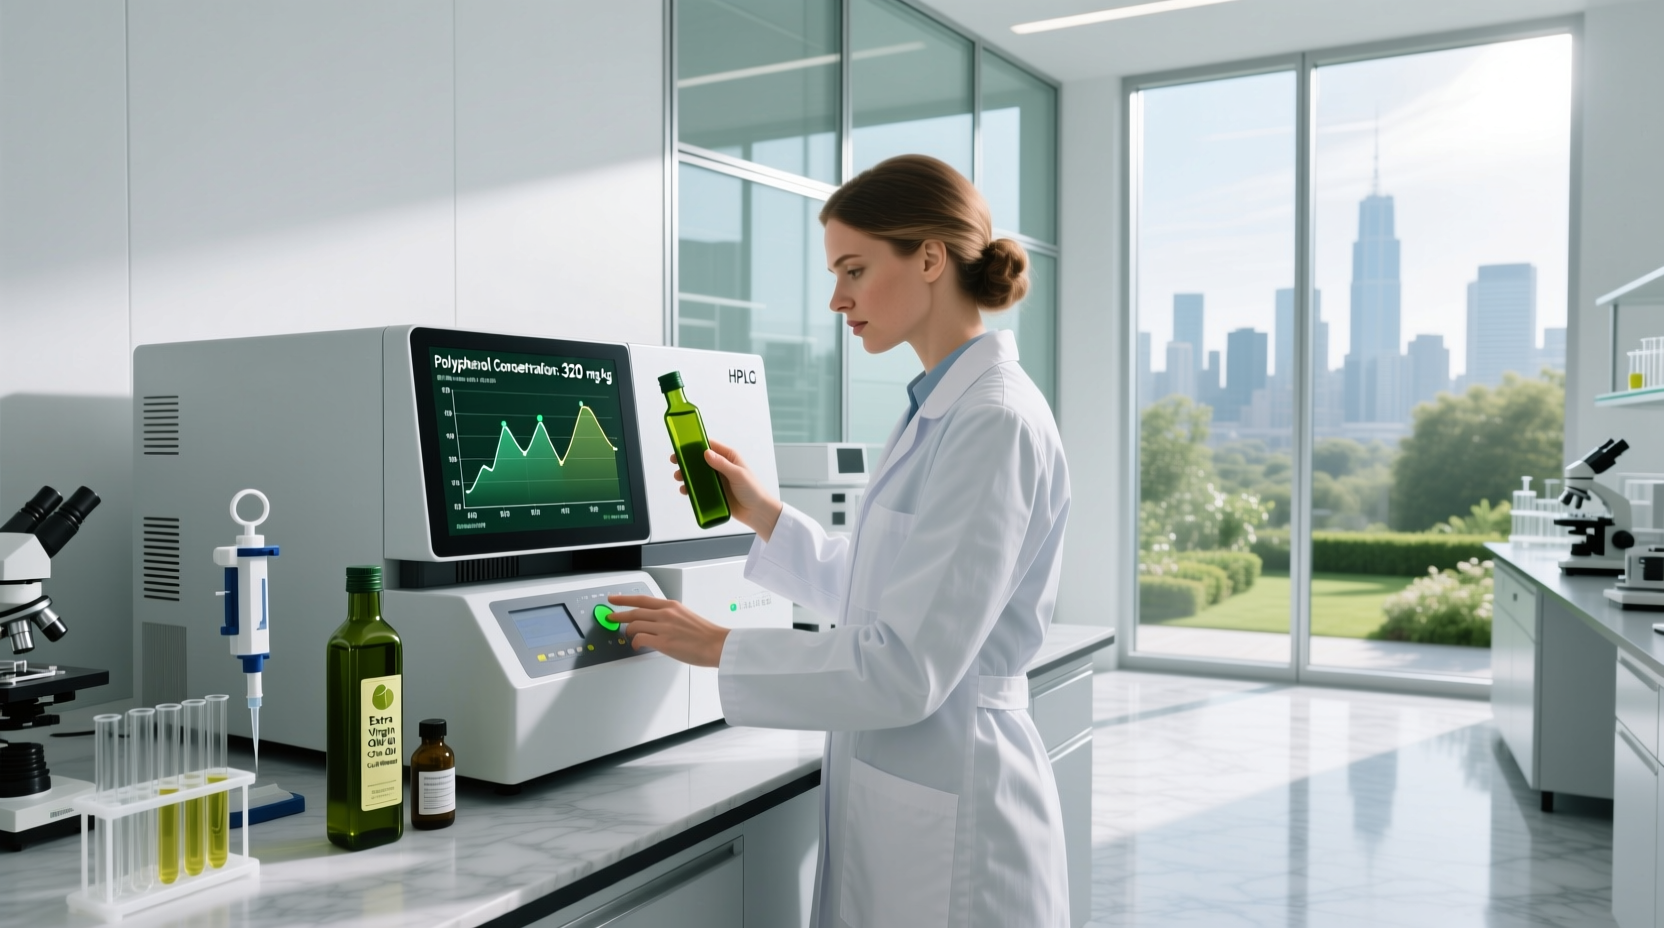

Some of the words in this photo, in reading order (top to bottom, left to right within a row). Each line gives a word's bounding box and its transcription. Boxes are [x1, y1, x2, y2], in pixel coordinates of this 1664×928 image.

[561, 362, 584, 379] 320
[728, 368, 757, 385] HPLC
[369, 715, 393, 726] Extra
